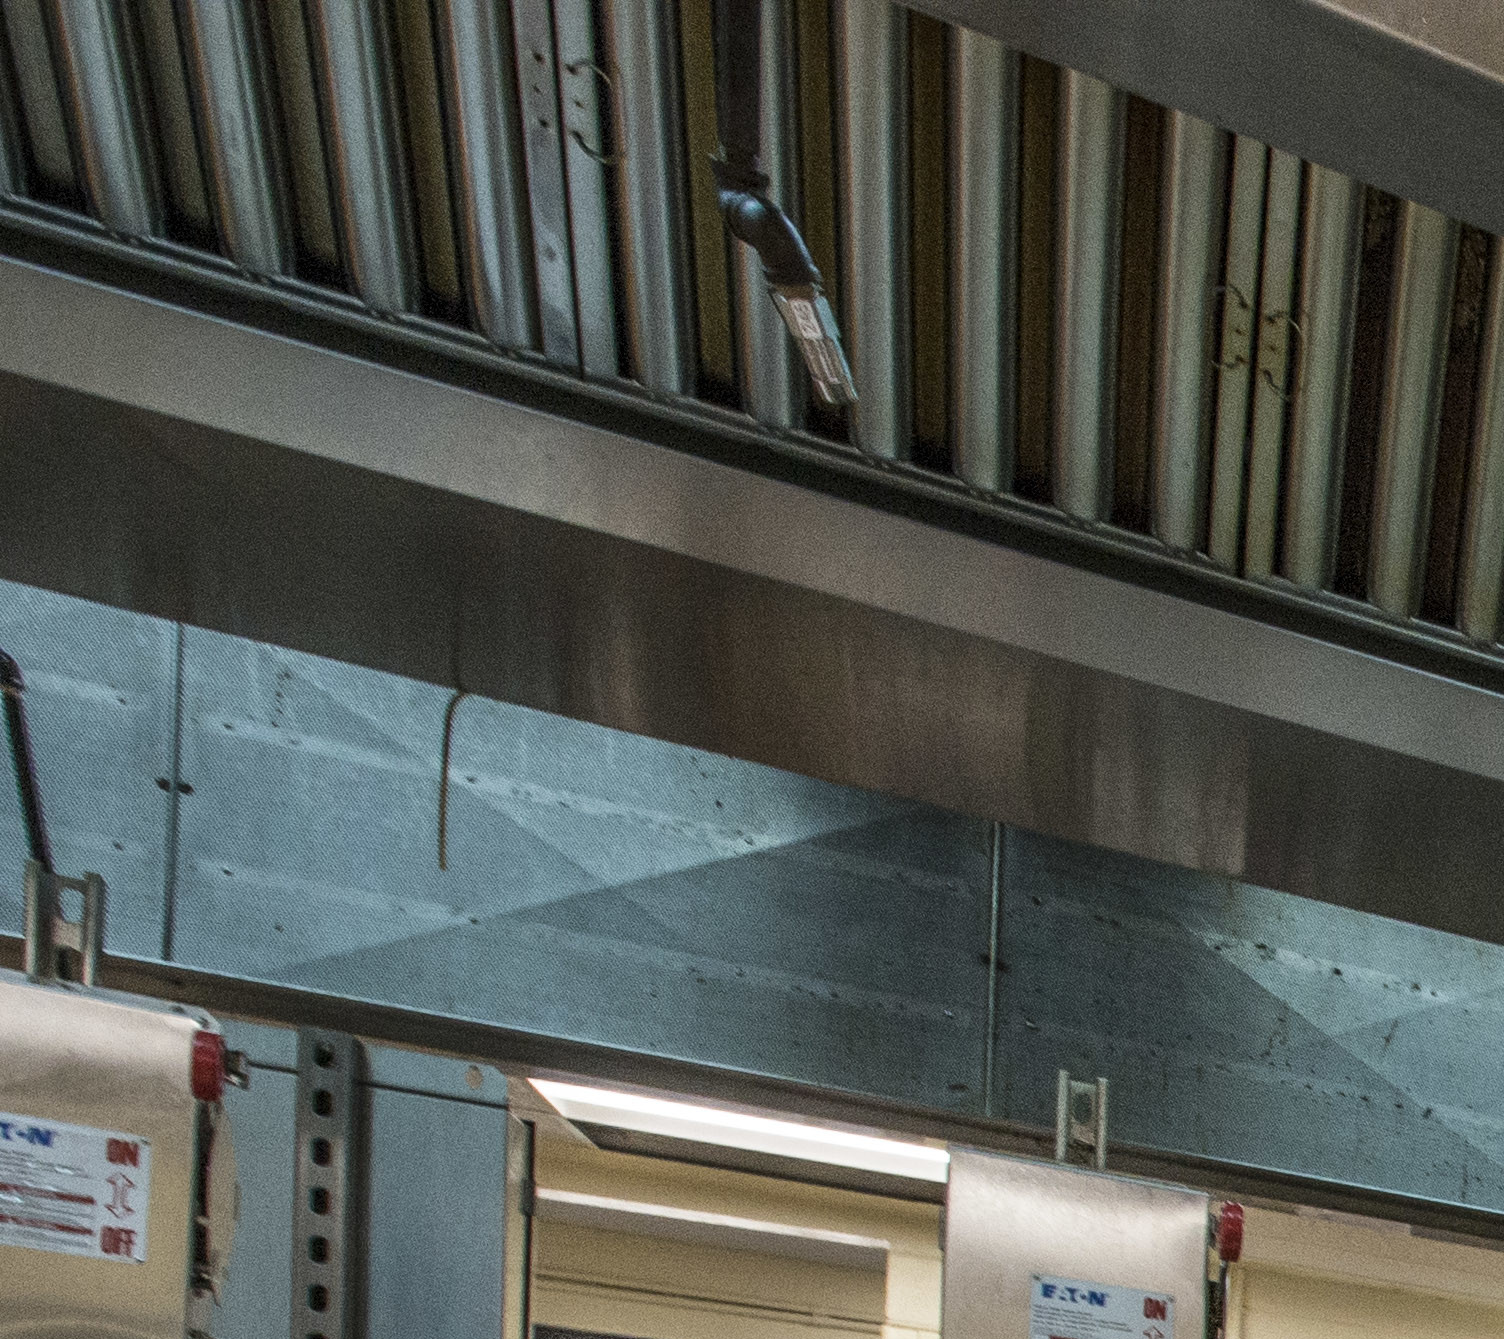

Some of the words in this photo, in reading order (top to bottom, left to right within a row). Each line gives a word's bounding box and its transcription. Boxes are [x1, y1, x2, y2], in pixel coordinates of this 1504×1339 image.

[105, 1137, 140, 1168] ON
[101, 1225, 137, 1257] OFF
[1143, 1296, 1167, 1321] ON
